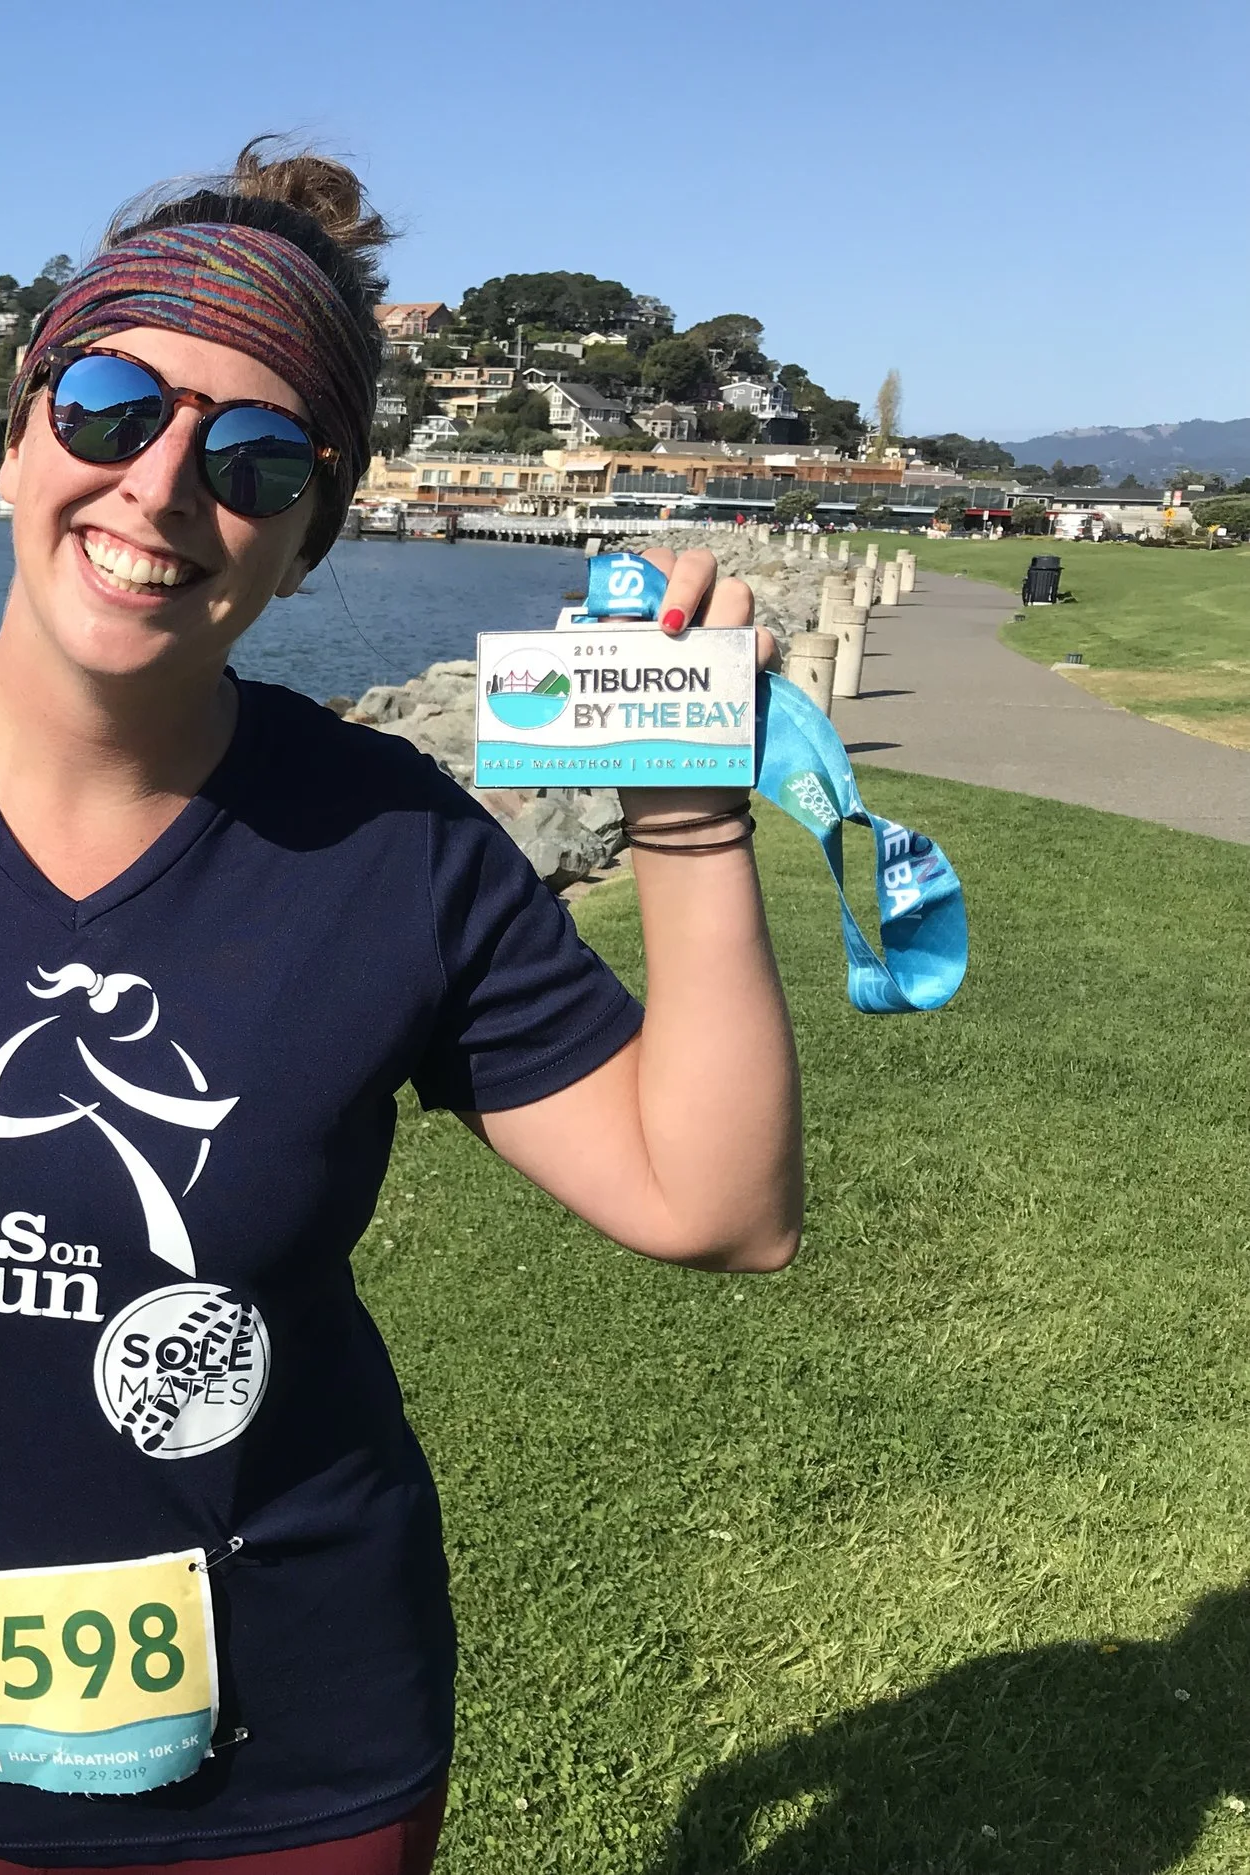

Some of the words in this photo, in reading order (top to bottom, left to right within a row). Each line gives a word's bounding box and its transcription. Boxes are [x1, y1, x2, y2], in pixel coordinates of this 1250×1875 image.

[574, 645, 618, 656] 2019
[573, 667, 711, 693] TIBURON
[574, 702, 616, 729] BY
[618, 702, 681, 728] THE
[685, 701, 749, 728] BAY
[484, 758, 523, 770] HALF
[533, 758, 622, 769] MARATHON
[646, 758, 675, 769] 10K
[683, 758, 718, 769] AND
[727, 758, 748, 768] 5K
[884, 861, 924, 919] BA
[50, 1241, 102, 1268] on
[121, 1333, 253, 1372] SOLE
[119, 1375, 249, 1405] MATES
[8, 1751, 48, 1763] HALF
[52, 1750, 139, 1766] MARATHON
[149, 1743, 173, 1760] 10K
[182, 1734, 199, 1749] 5K
[73, 1766, 147, 1781] 9.29.2019
